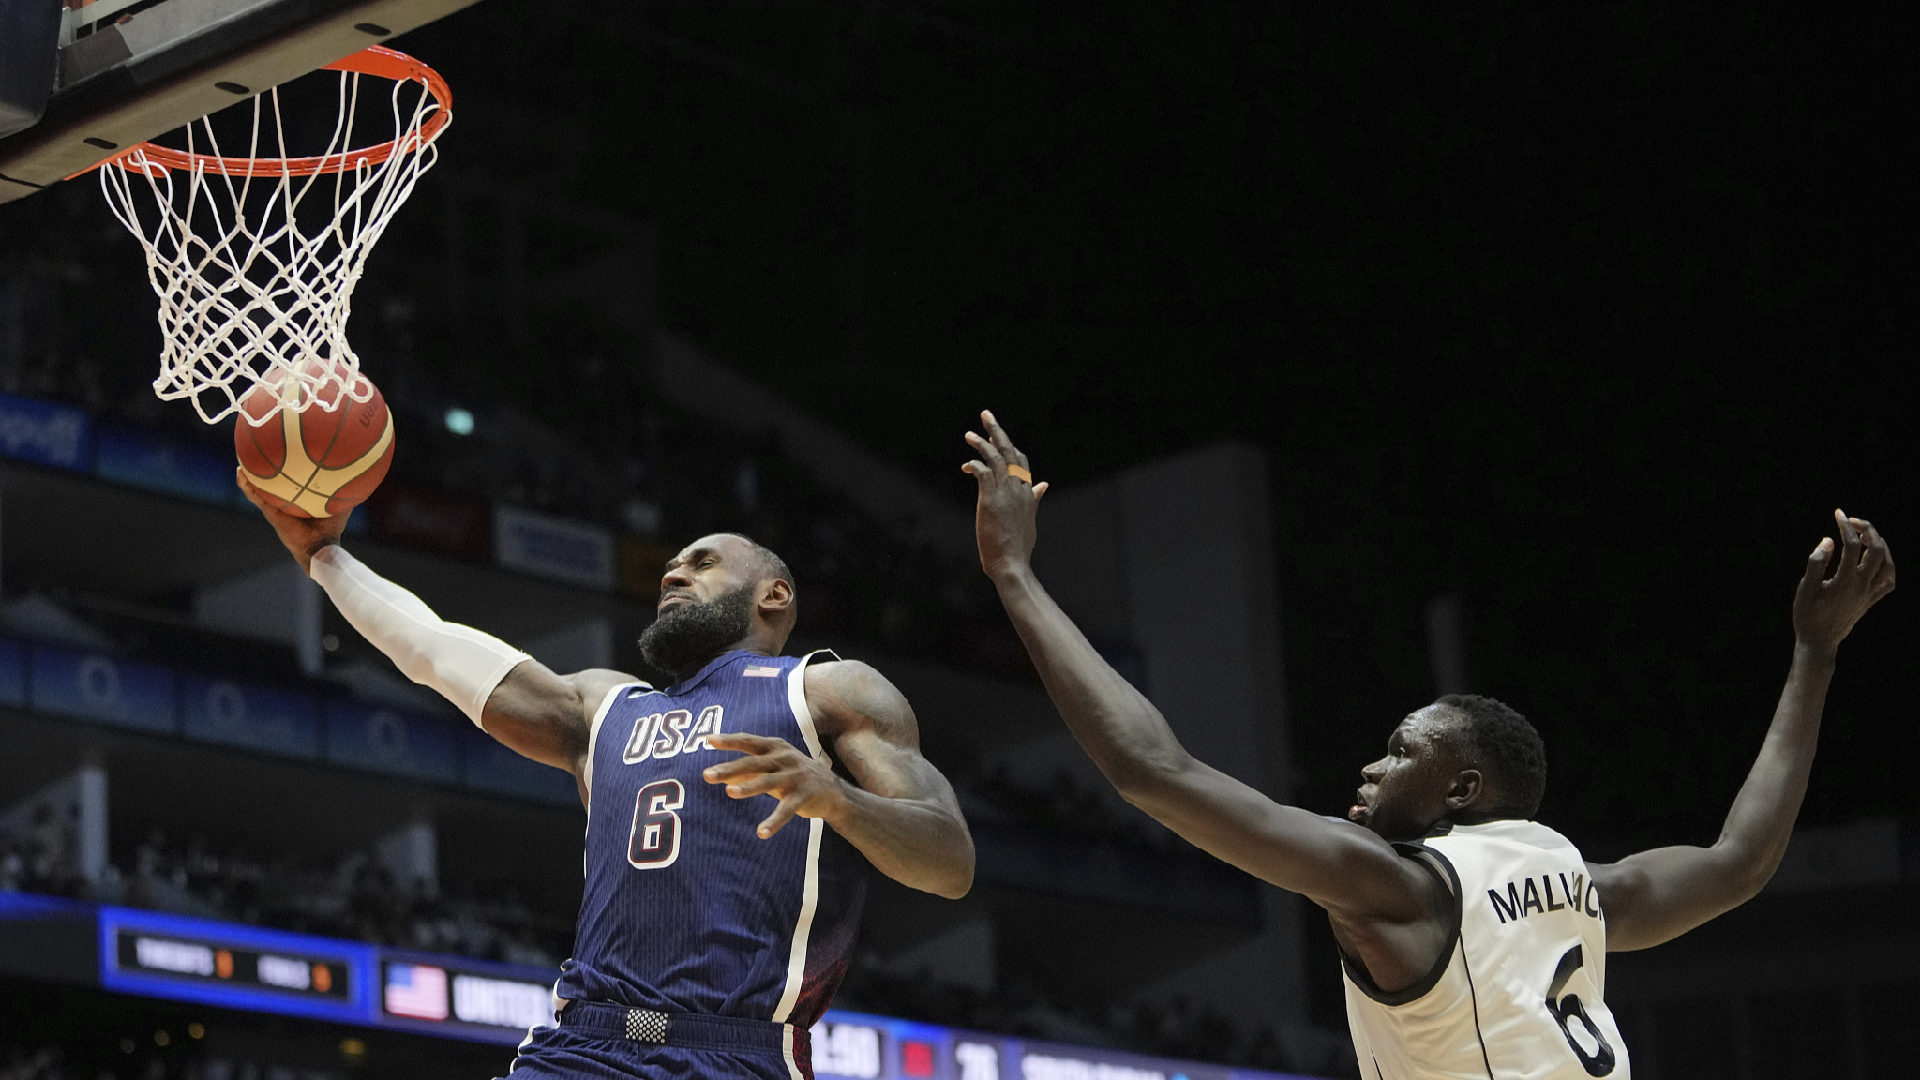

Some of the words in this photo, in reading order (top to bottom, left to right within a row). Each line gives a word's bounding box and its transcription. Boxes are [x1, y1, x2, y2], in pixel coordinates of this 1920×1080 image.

[623, 704, 724, 765] USA
[627, 778, 685, 870] 6
[1487, 871, 1602, 924] MALUAC
[1545, 943, 1616, 1078] 6
